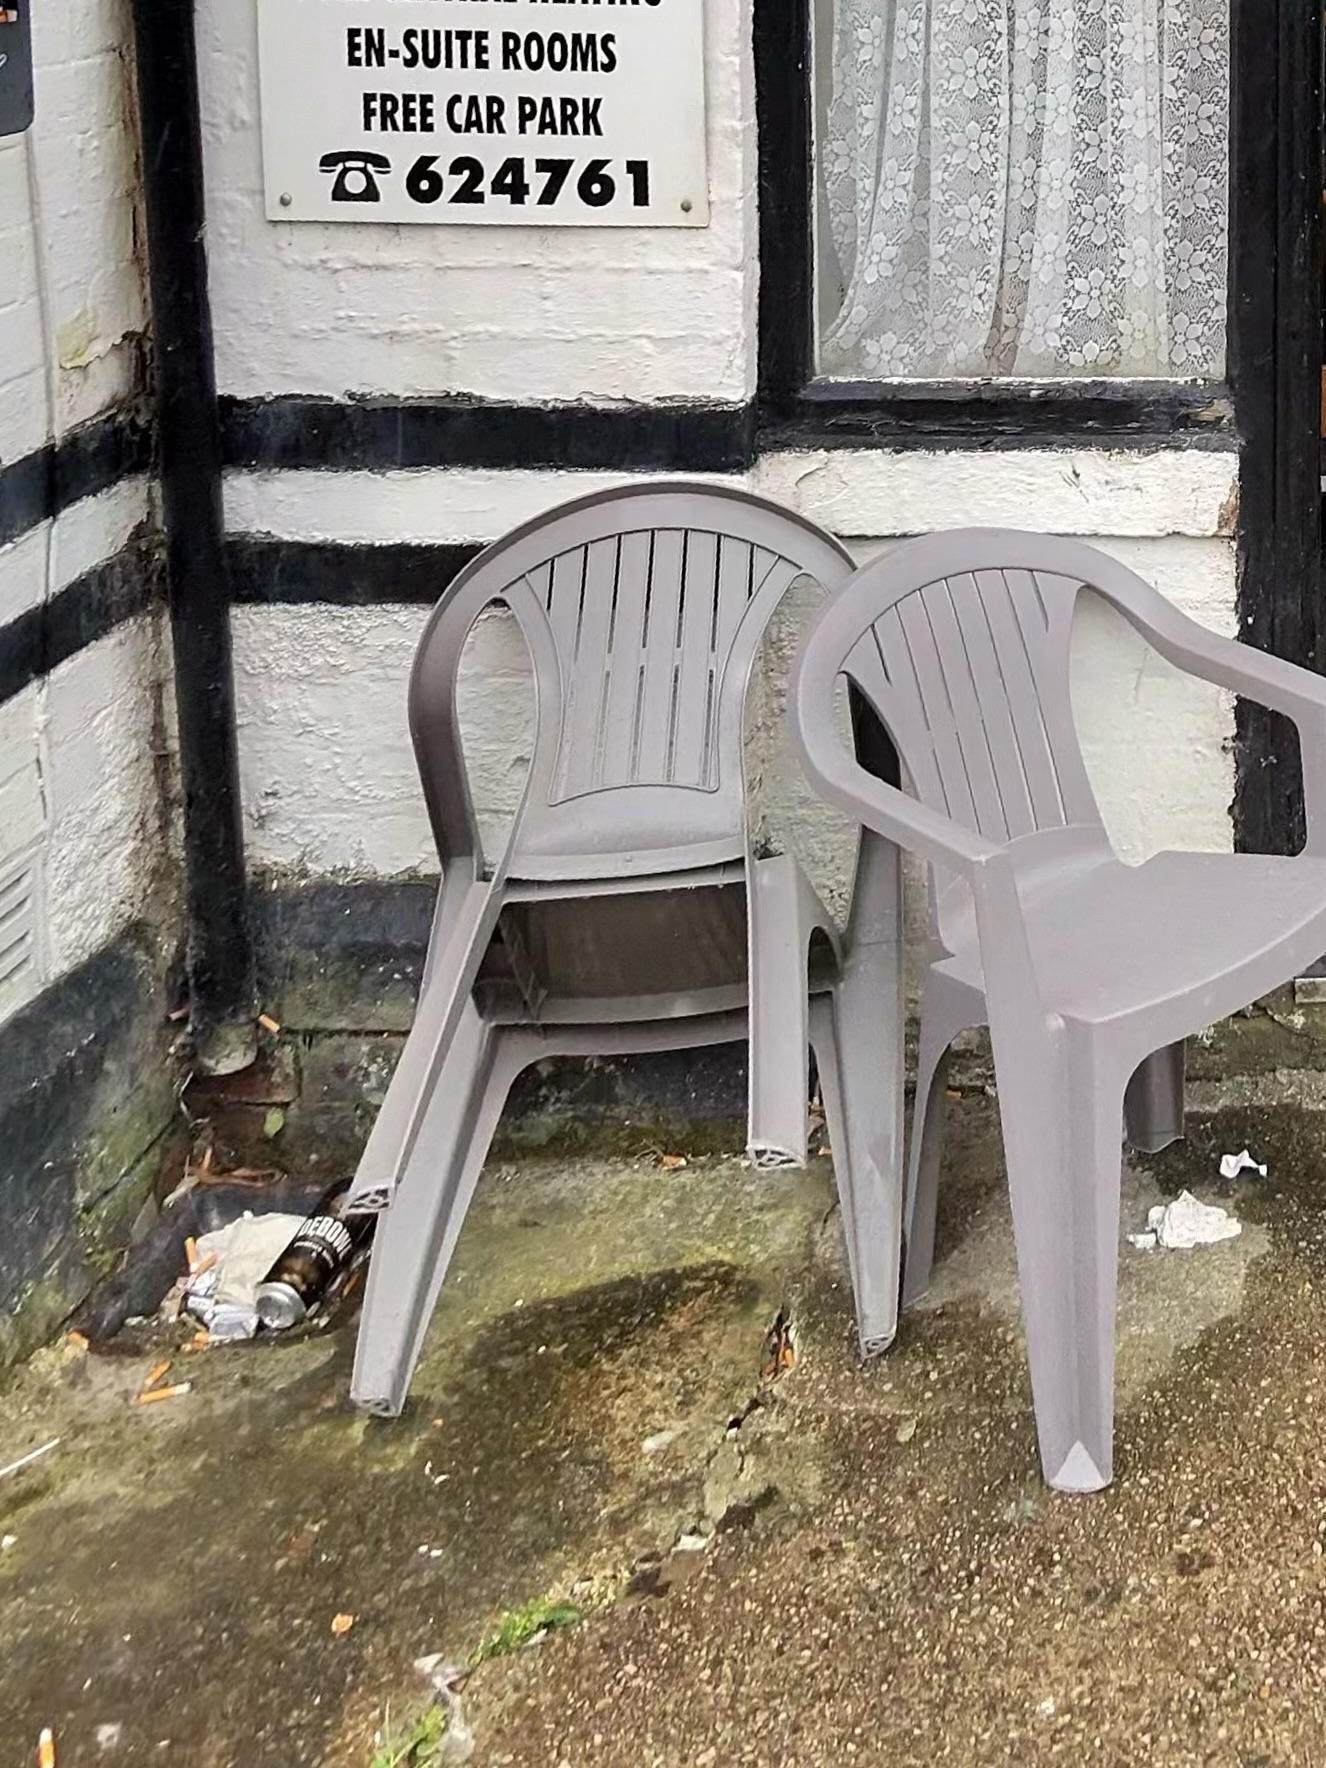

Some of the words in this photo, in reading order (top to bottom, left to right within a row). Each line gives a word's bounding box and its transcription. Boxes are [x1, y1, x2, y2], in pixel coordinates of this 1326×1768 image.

[347, 27, 490, 70] EN-SUITE
[501, 31, 617, 74] ROOMS
[362, 92, 435, 133] FREE
[445, 93, 507, 134] CAR
[517, 95, 603, 137] PARK
[405, 155, 650, 208] 624761
